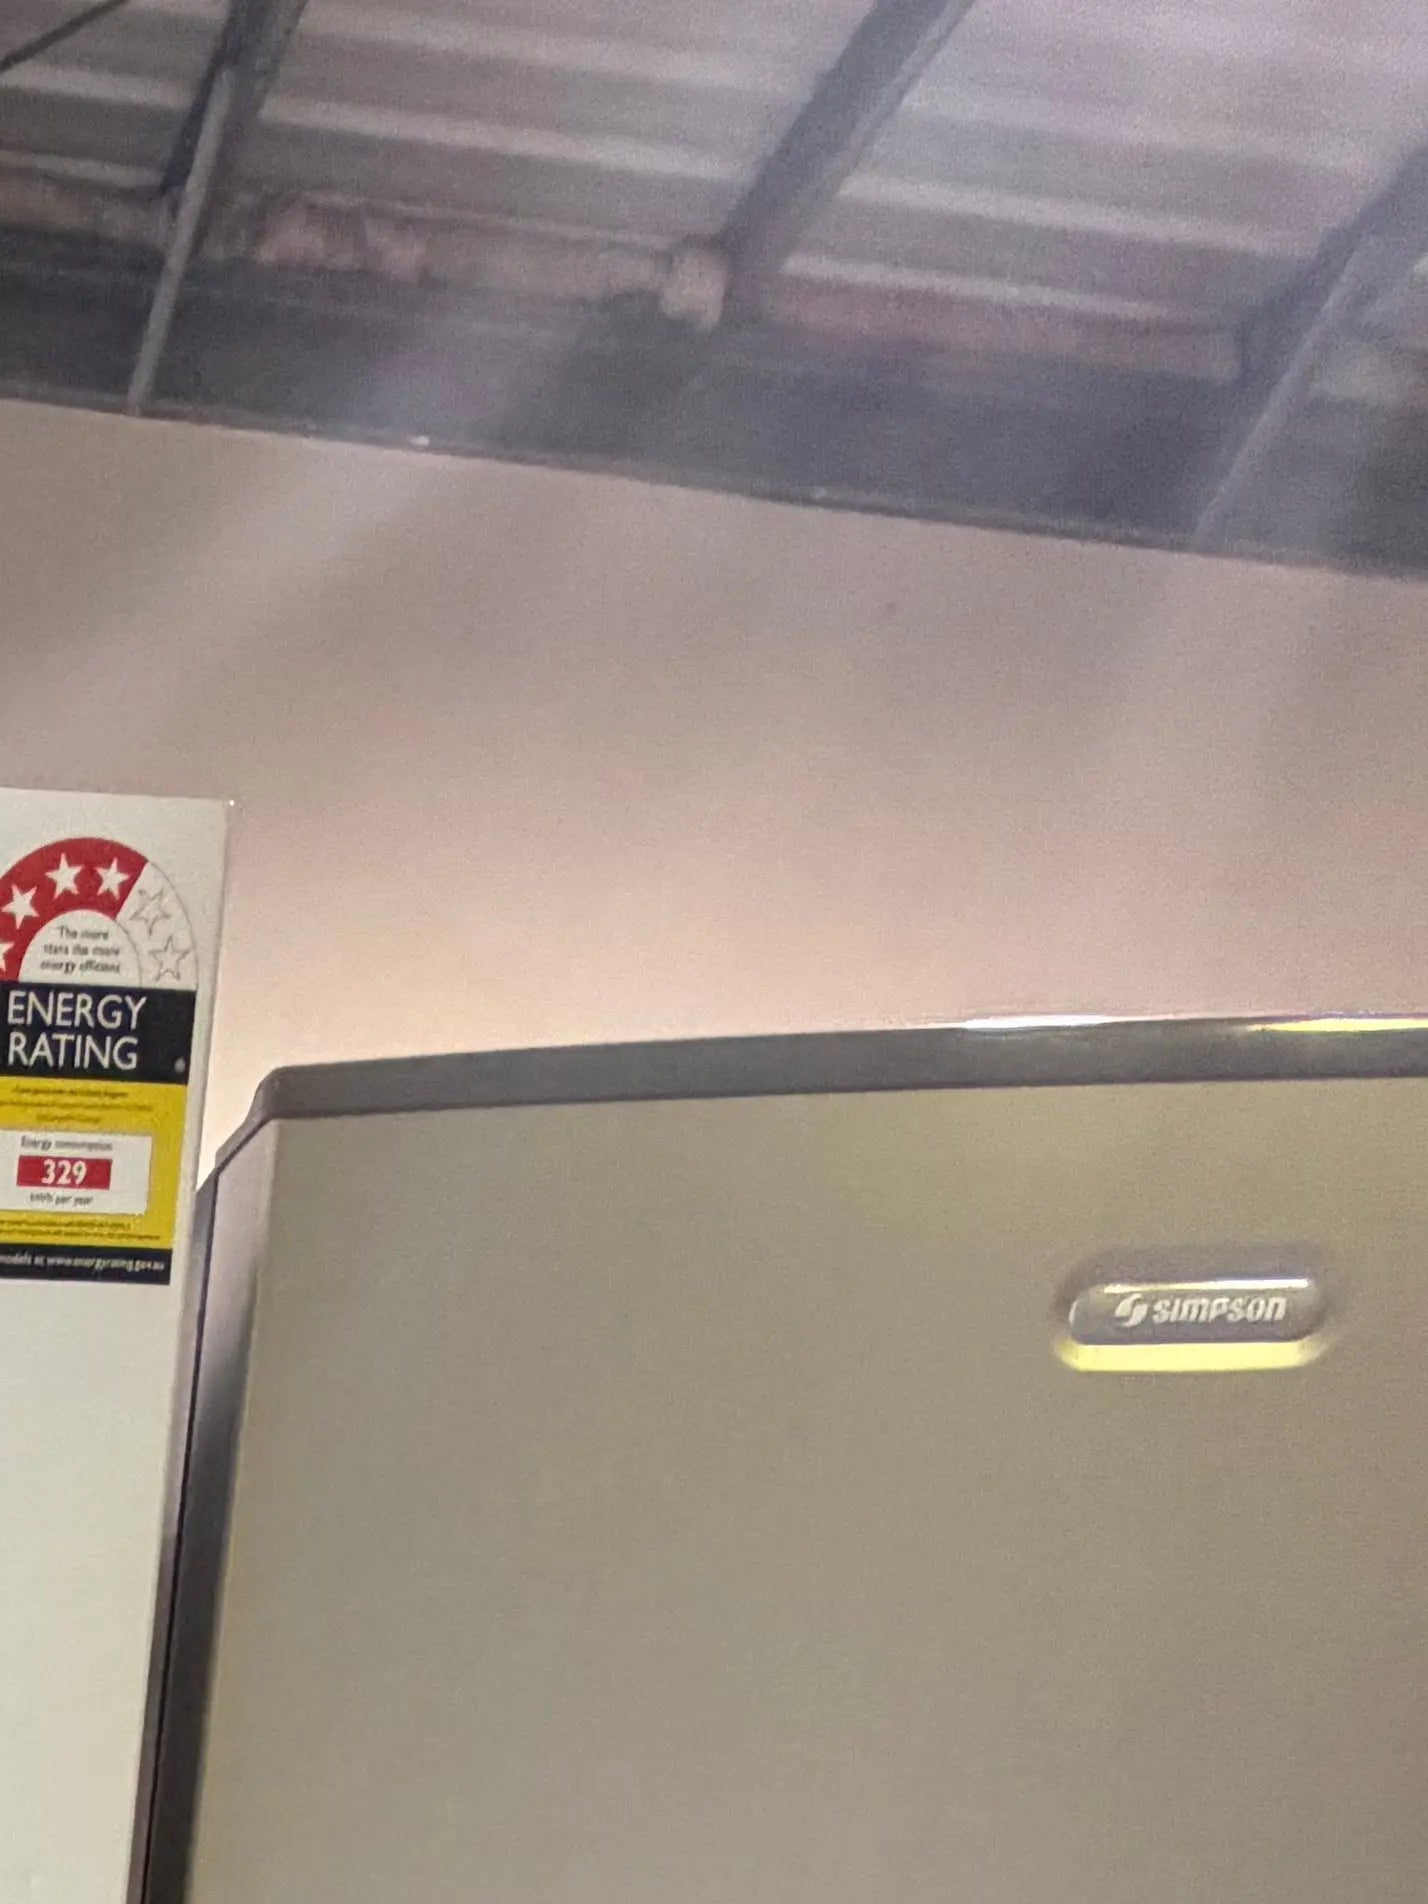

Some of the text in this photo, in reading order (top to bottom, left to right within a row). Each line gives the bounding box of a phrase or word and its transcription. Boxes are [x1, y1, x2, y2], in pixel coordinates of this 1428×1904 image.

[7, 990, 147, 1030] ENERGY
[8, 1032, 138, 1071] RATING
[41, 1158, 88, 1186] 329
